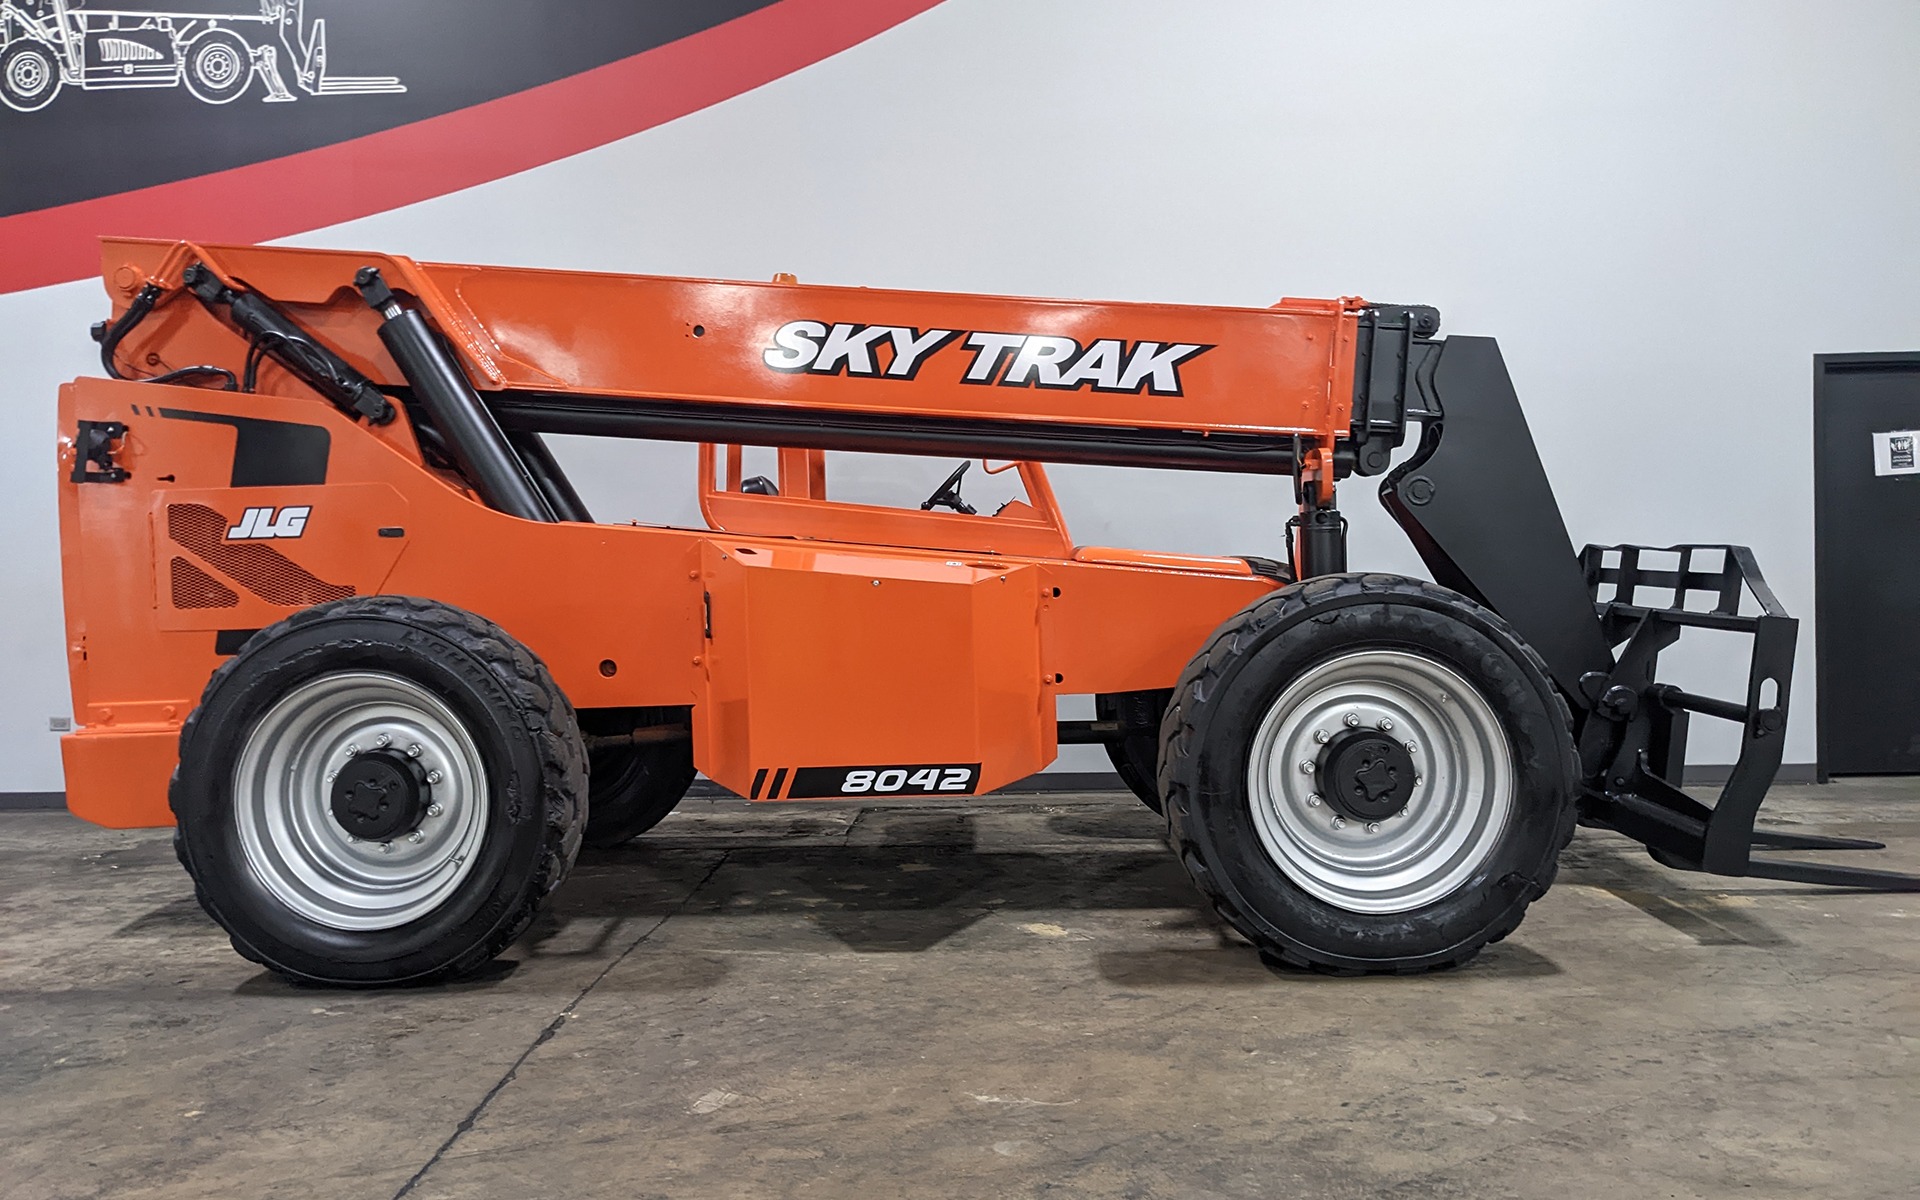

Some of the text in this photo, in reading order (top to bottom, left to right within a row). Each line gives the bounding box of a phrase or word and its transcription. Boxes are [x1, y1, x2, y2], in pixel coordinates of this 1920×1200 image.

[763, 321, 1218, 397] SKY TRAK
[226, 505, 313, 540] JLG
[841, 768, 971, 793] 8042
